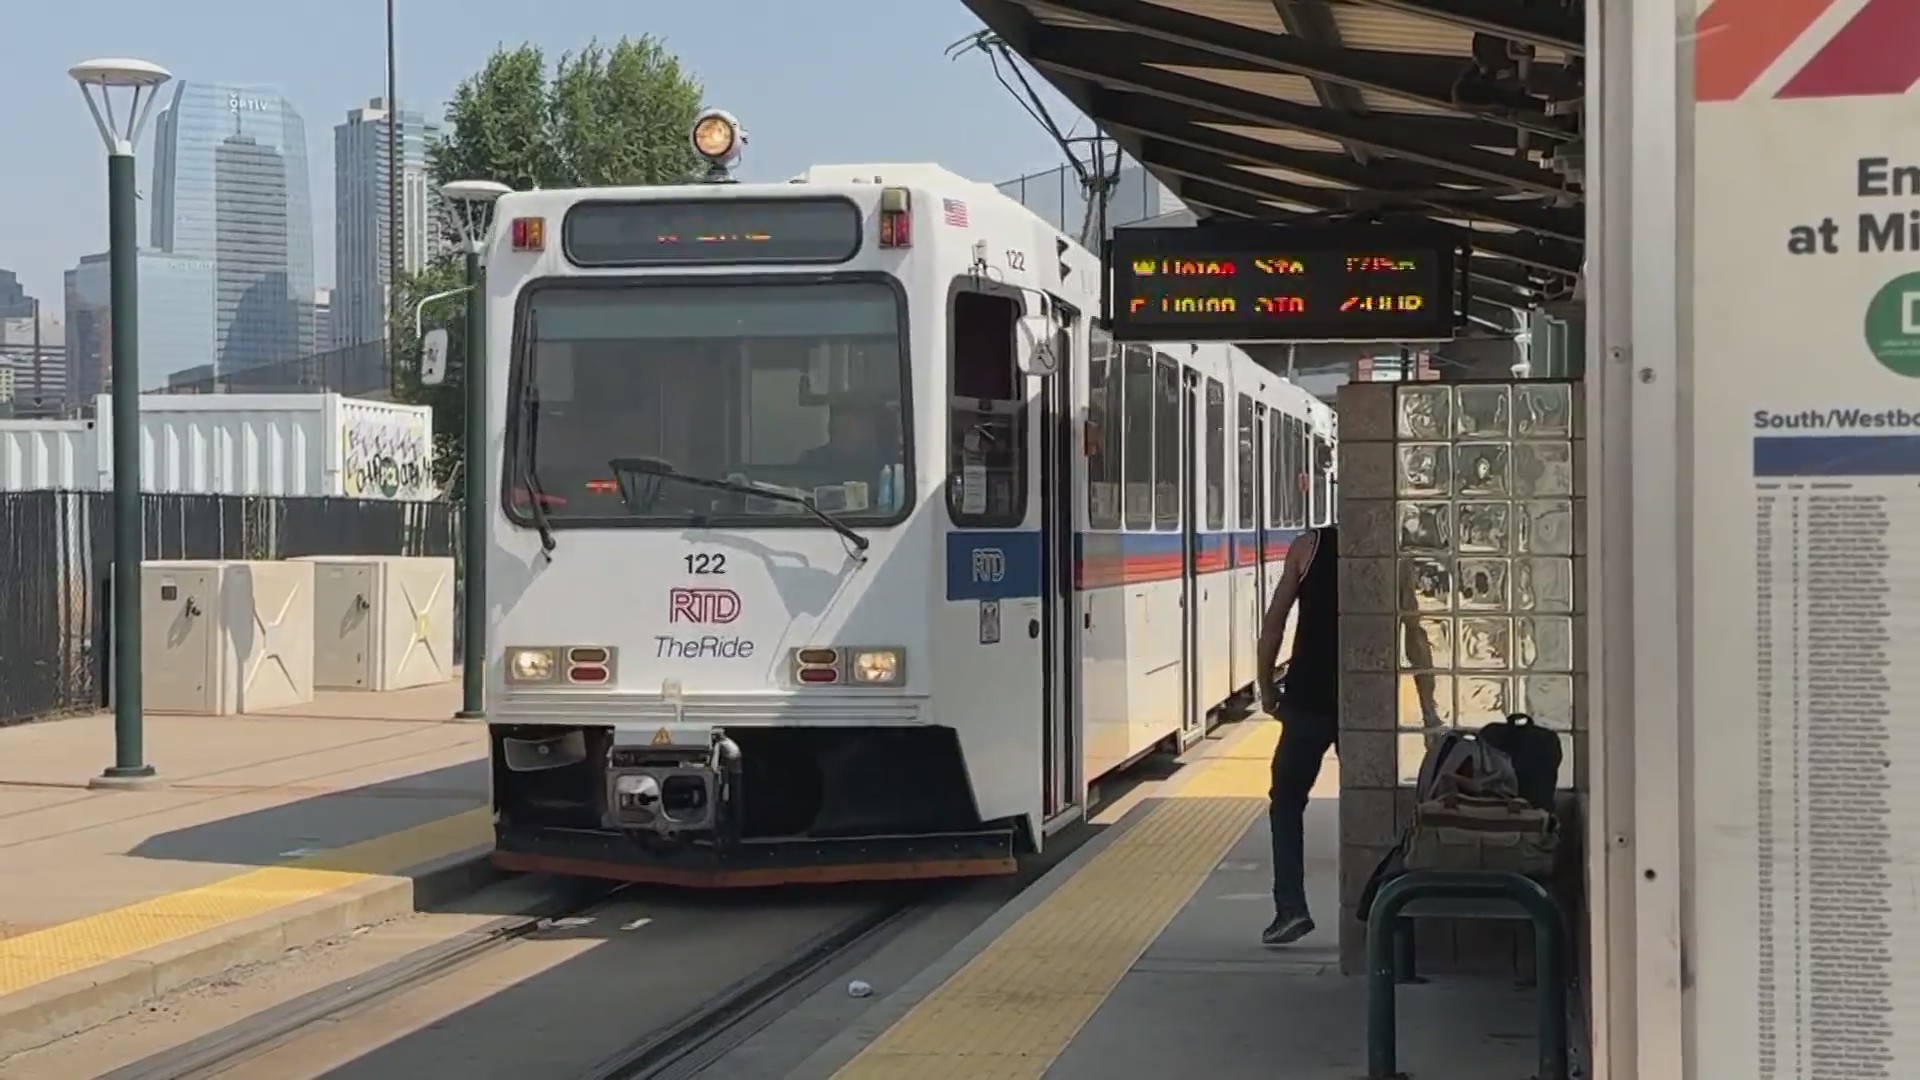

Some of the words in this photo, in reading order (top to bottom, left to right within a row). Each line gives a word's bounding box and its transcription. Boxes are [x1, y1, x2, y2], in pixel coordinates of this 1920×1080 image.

[1787, 216, 1840, 255] at
[1858, 210, 1920, 253] Mi
[1006, 248, 1026, 272] 122
[684, 553, 727, 575] 122
[972, 547, 1006, 583] RTD
[669, 587, 742, 624] RTD
[654, 635, 754, 659] TheRide
